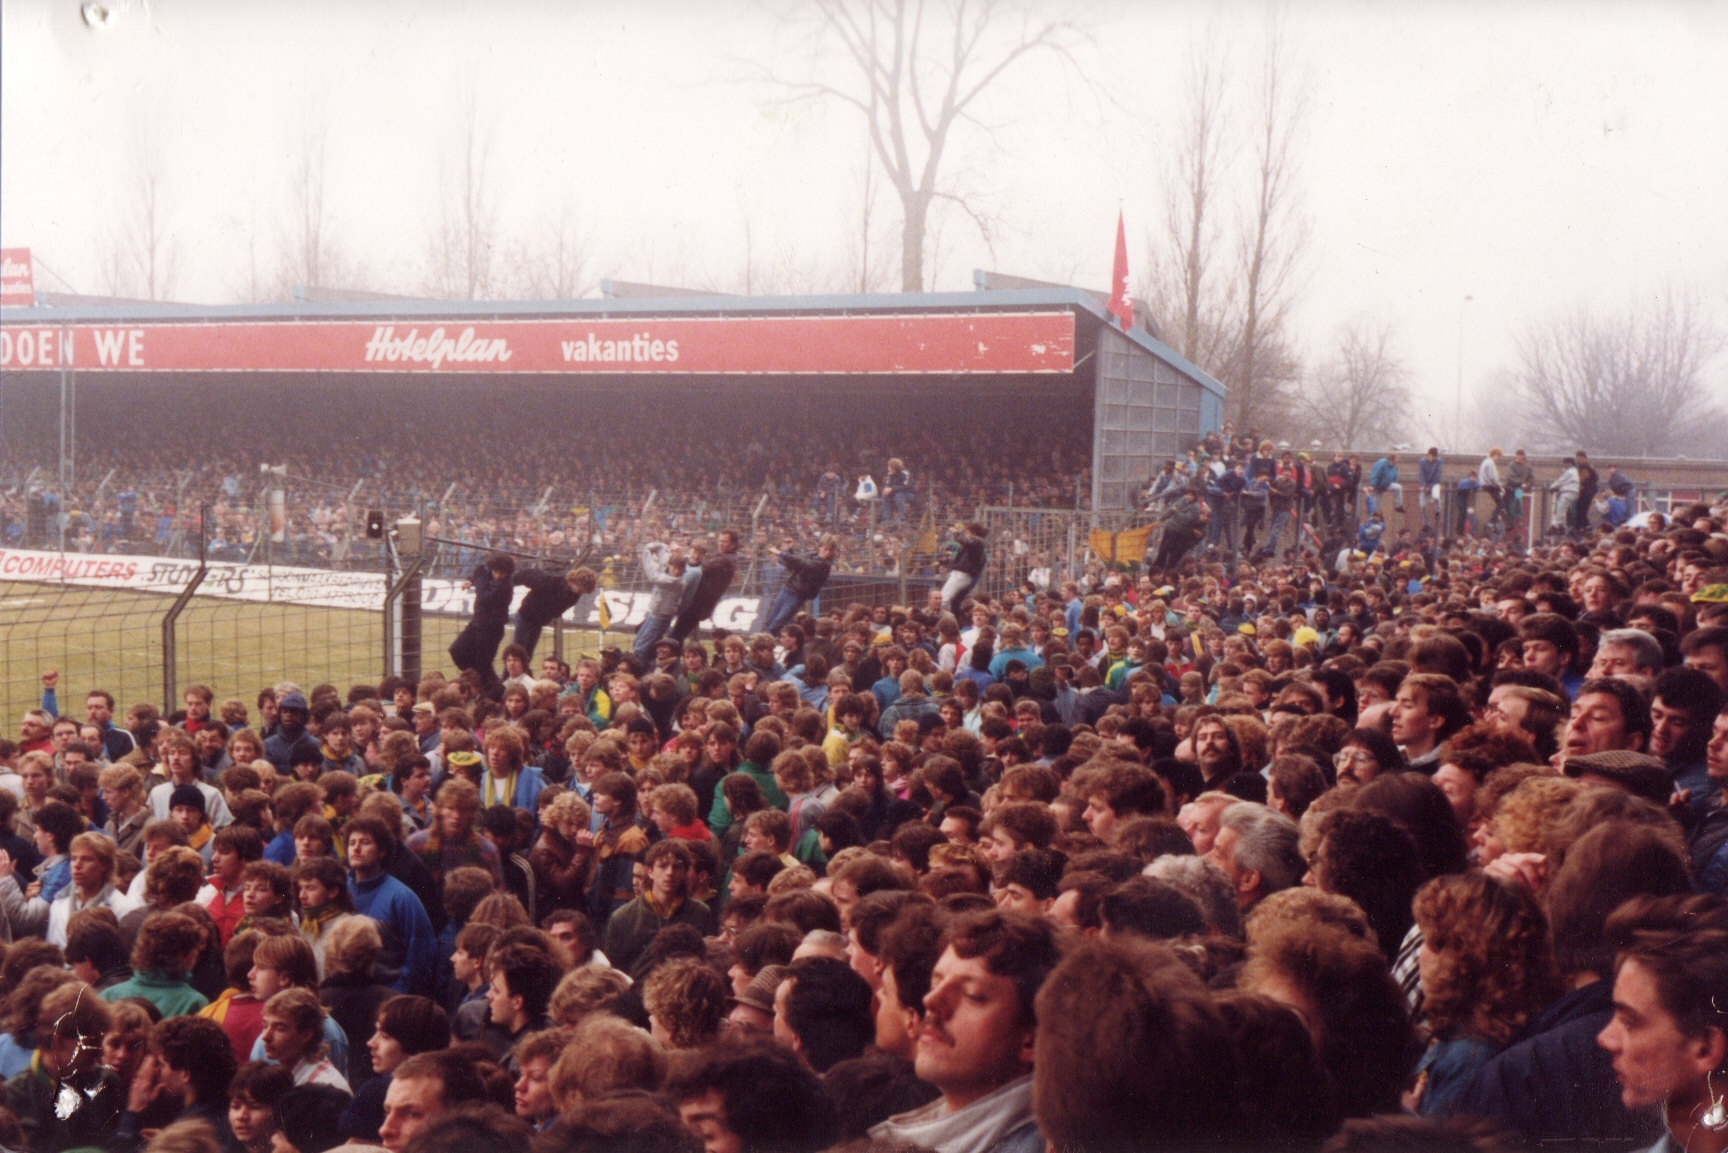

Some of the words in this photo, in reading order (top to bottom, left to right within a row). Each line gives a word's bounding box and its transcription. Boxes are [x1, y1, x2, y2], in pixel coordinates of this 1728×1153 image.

[93, 330, 145, 366] WE
[365, 326, 513, 368] Hotelplan
[561, 332, 680, 362] vakanties
[2, 555, 138, 581] COMPUTERS
